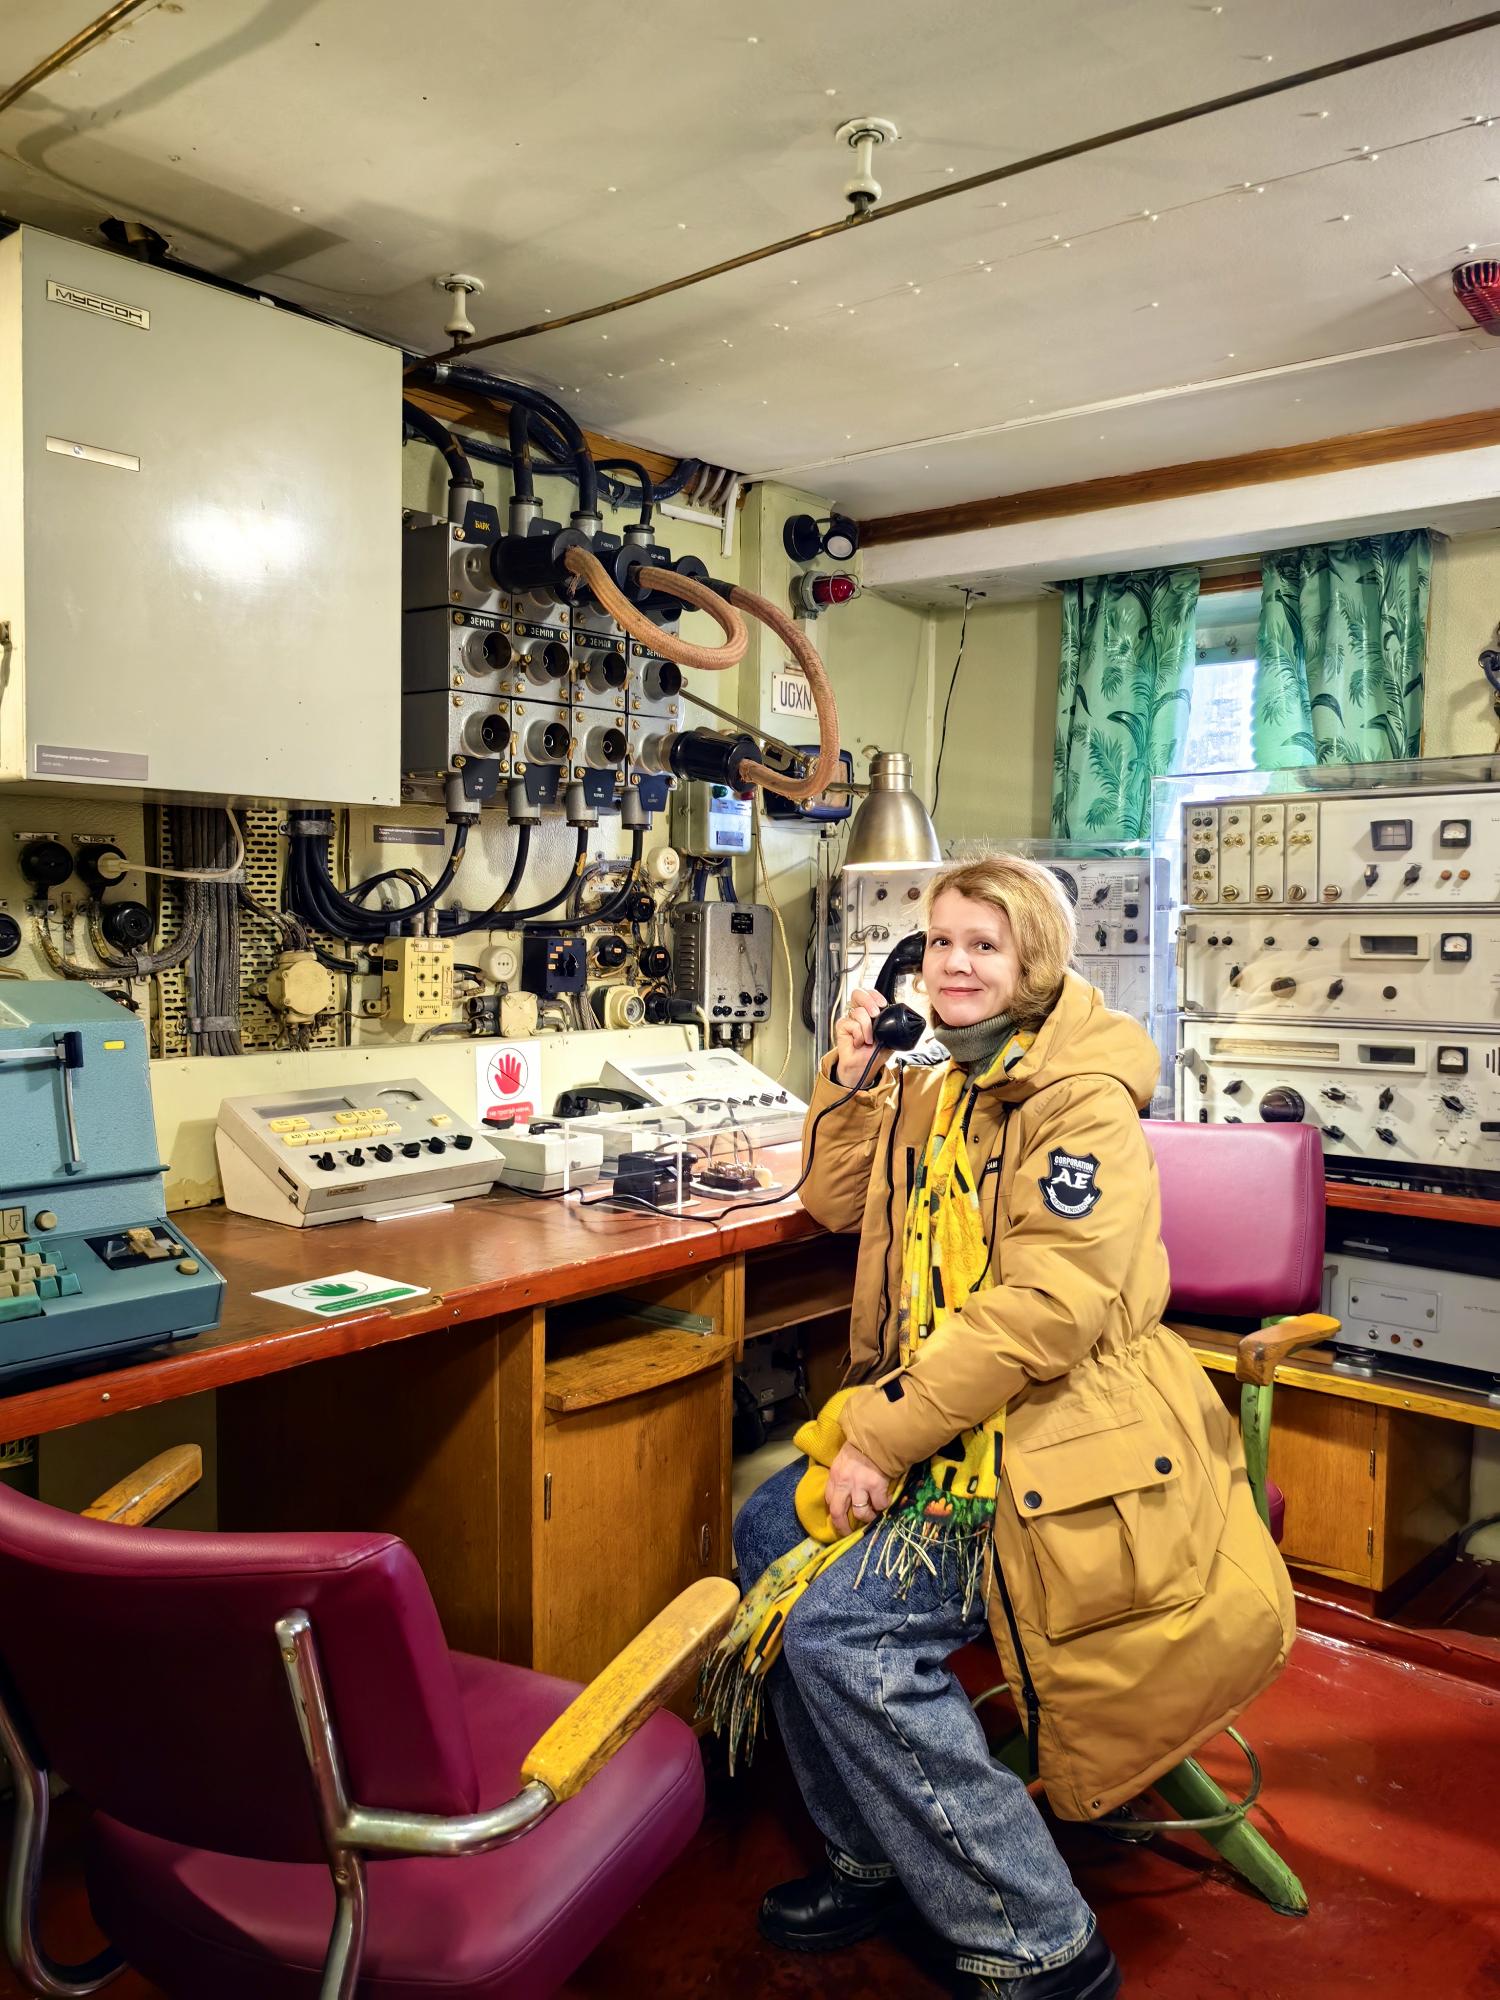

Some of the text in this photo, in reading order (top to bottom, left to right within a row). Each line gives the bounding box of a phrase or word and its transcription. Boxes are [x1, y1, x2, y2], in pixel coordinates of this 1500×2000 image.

[55, 288, 143, 323] МУССОН
[470, 616, 495, 629] ЗЕМЛЯ
[530, 627, 554, 638] ЗЕМЛЯ
[780, 680, 812, 712] UGXN
[1054, 1155, 1094, 1171] CORPORATION
